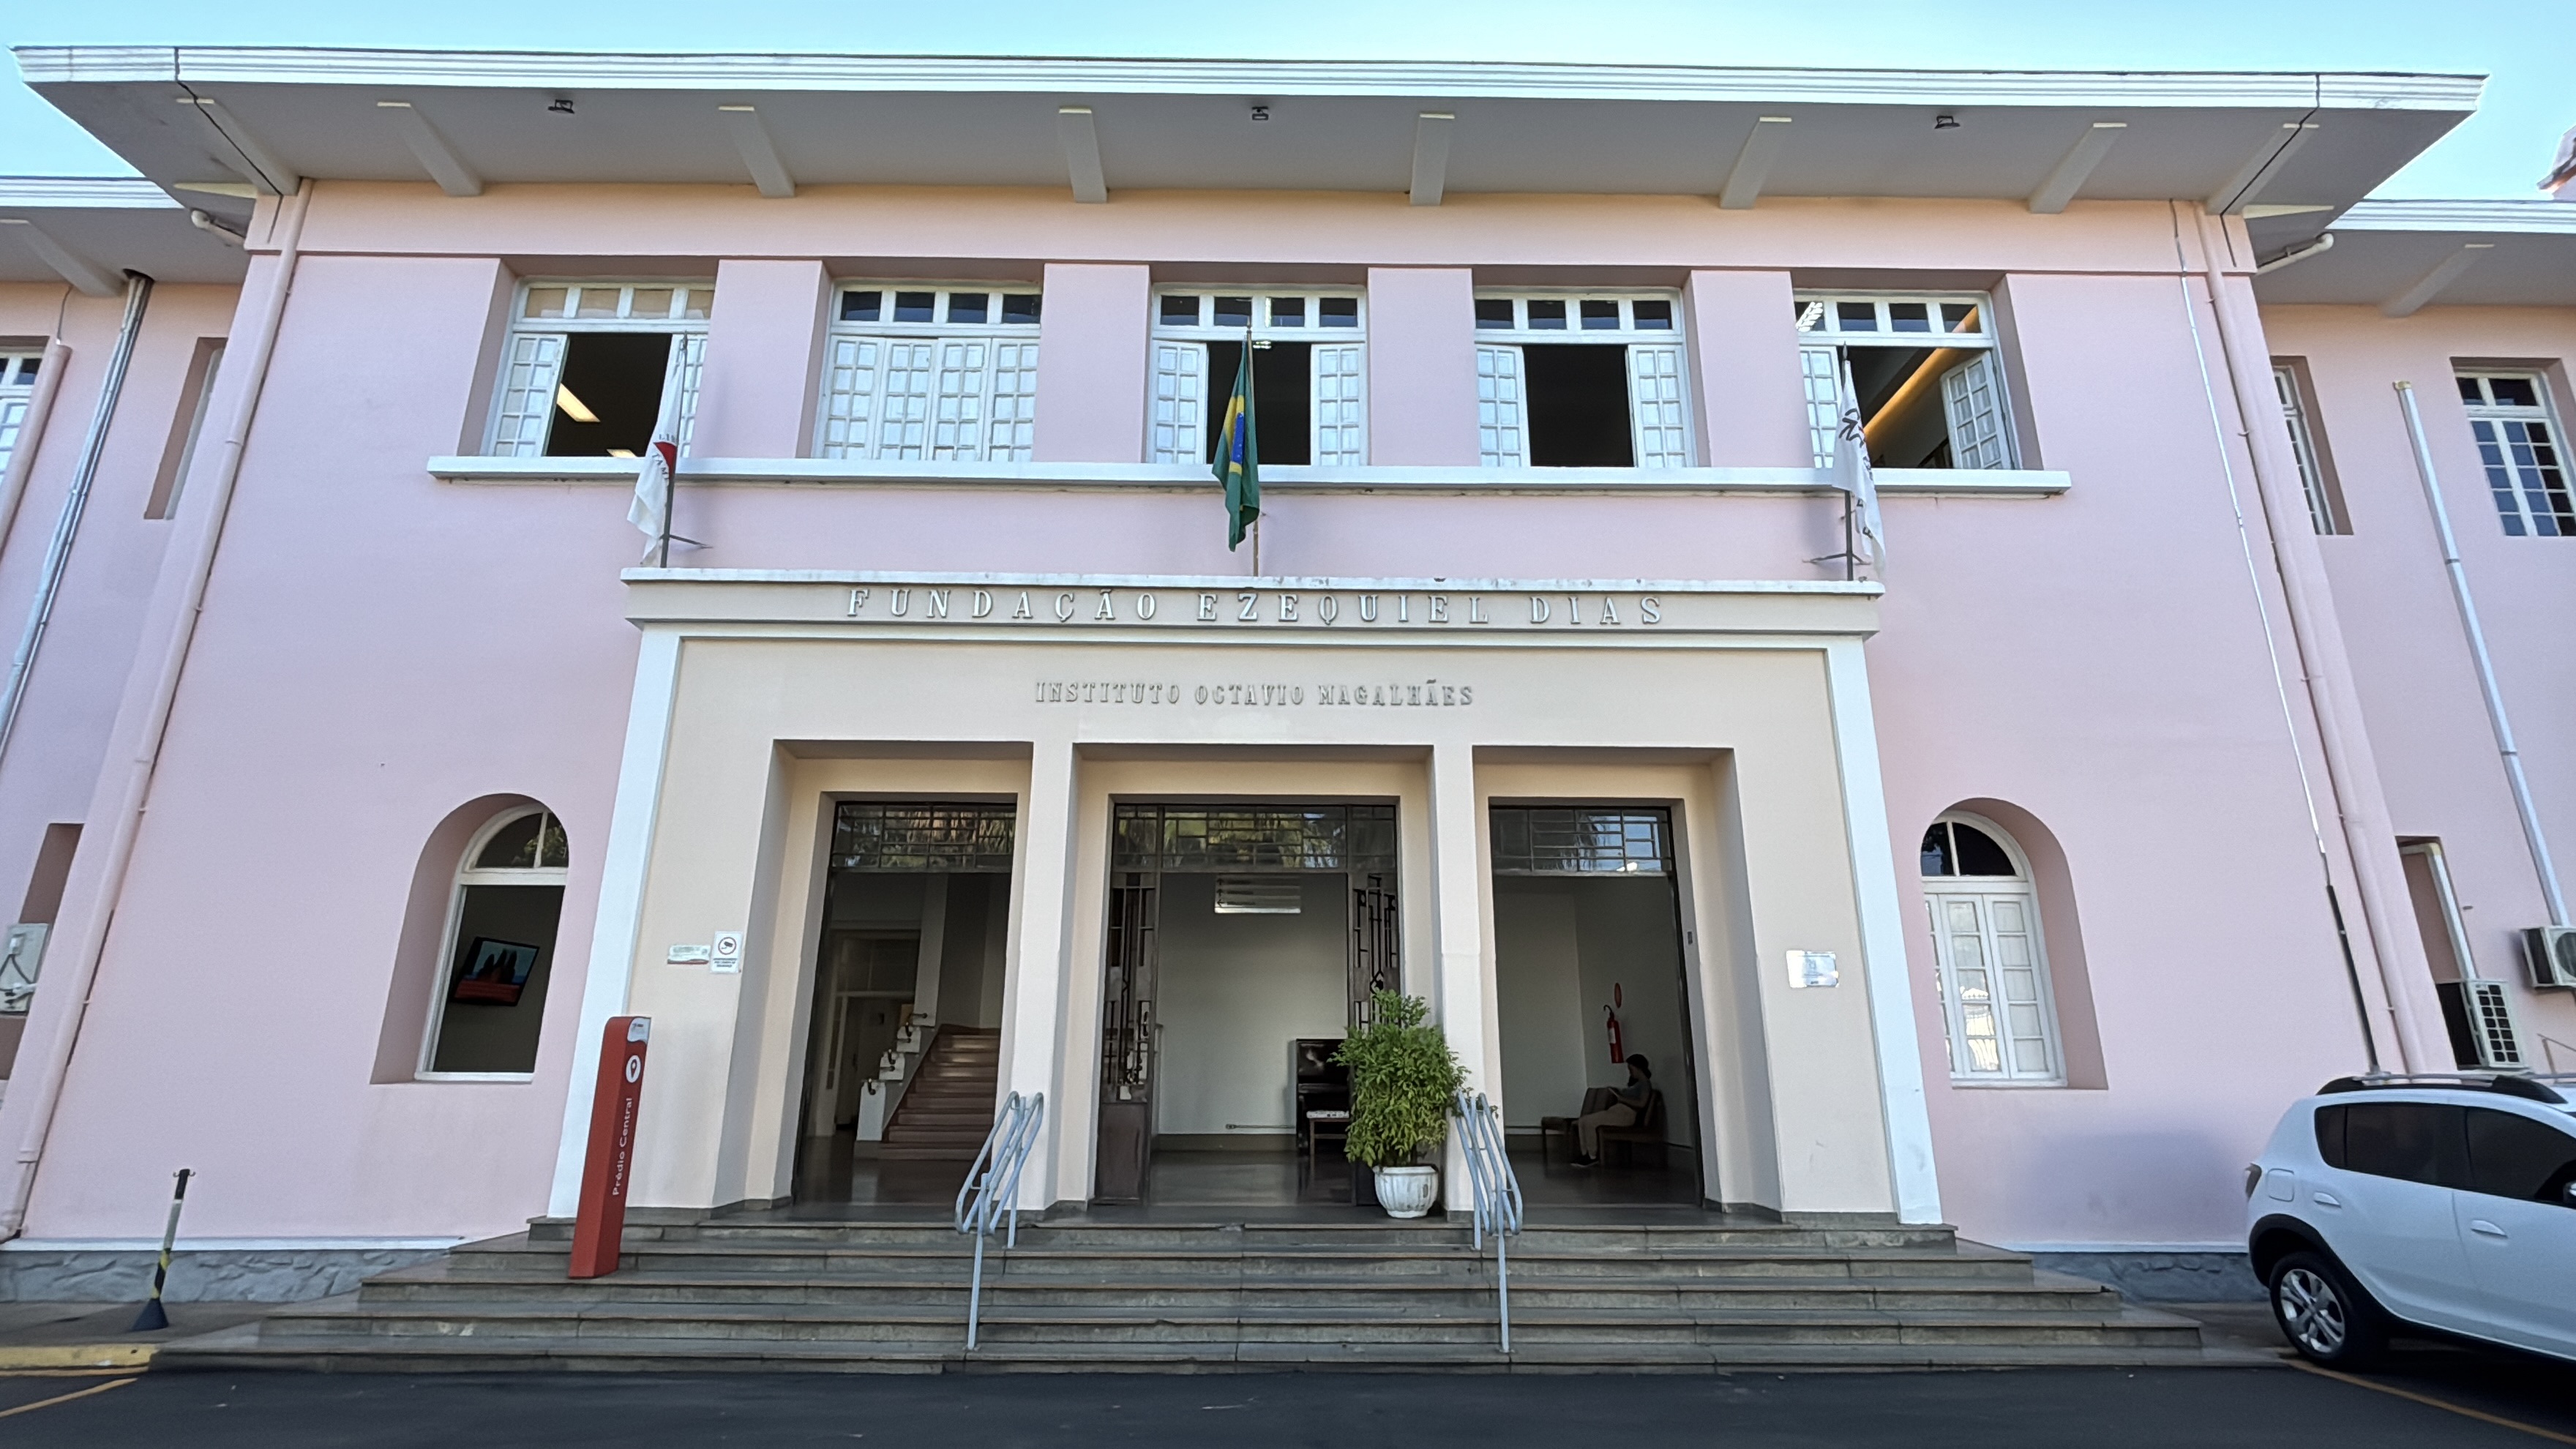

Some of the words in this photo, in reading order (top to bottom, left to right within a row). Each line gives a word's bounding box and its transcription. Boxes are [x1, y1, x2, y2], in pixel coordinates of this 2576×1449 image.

[846, 588, 1157, 622] FUNDAÇÃO
[1197, 592, 1489, 625] EZEQUIEL
[1530, 595, 1662, 625] DIAS
[1035, 681, 1180, 705] INSTITUTO
[1194, 681, 1305, 706] OCTAVIO
[1318, 678, 1474, 707] MAGALHÃES
[612, 1150, 626, 1196] Prédio
[619, 1097, 633, 1147] Central
